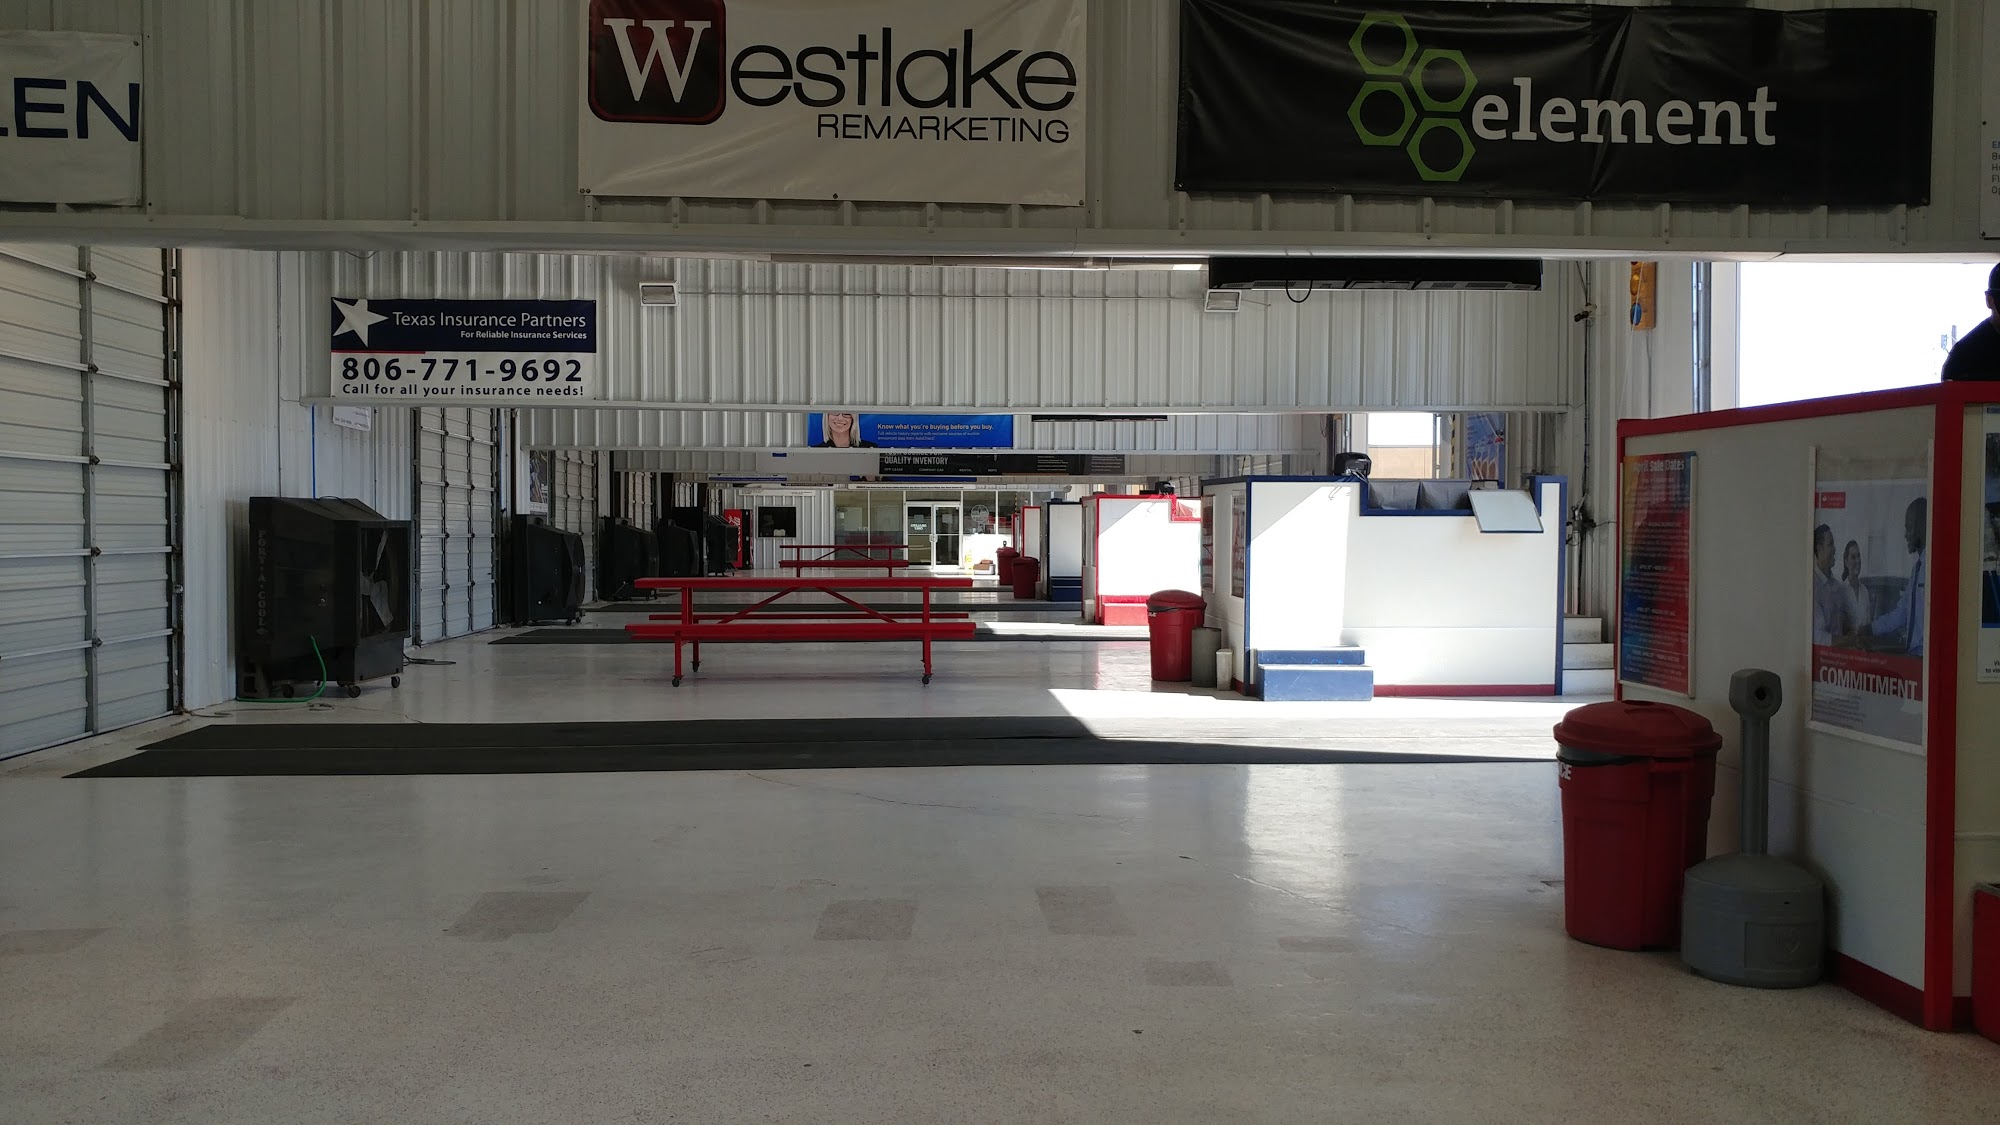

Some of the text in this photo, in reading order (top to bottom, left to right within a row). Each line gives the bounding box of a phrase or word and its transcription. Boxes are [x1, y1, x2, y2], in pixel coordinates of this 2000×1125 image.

[603, 17, 1078, 112] Westlake
[0, 77, 140, 142] EN
[1471, 77, 1778, 146] element
[817, 114, 1070, 144] REMARKETING
[392, 311, 586, 328] Texas Insurance Partners
[460, 330, 587, 340] For Reliable Insurance Services
[341, 357, 582, 382] 806-771-9692
[342, 383, 584, 398] Call for all your insurance needs!
[930, 423, 949, 431] buying
[884, 456, 949, 465] QUALITY INVENTORY
[1649, 460, 1664, 472] Sale
[1665, 459, 1685, 471] Dates
[1819, 665, 1918, 700] COMMITMENT
